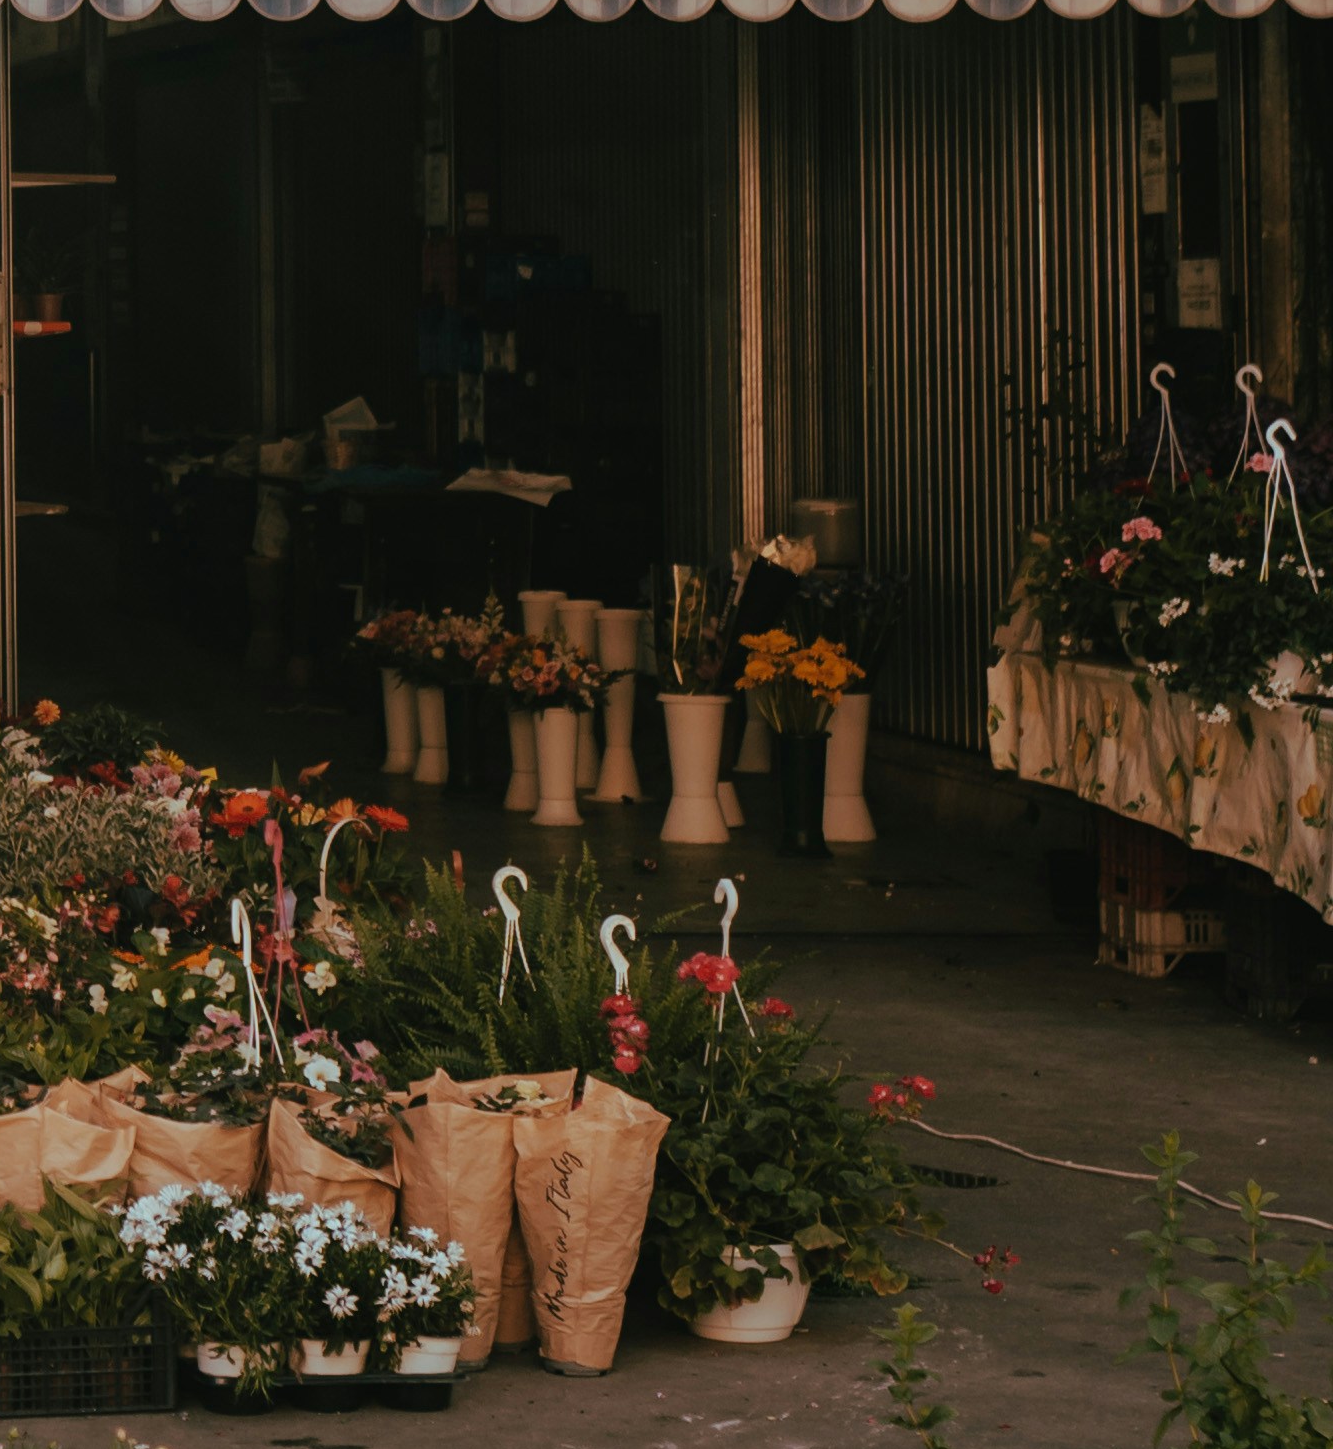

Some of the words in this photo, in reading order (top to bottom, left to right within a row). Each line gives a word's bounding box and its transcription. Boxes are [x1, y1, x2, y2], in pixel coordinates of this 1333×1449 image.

[545, 1150, 584, 1223] Italy
[555, 1228, 568, 1254] in
[543, 1257, 570, 1322] Made
